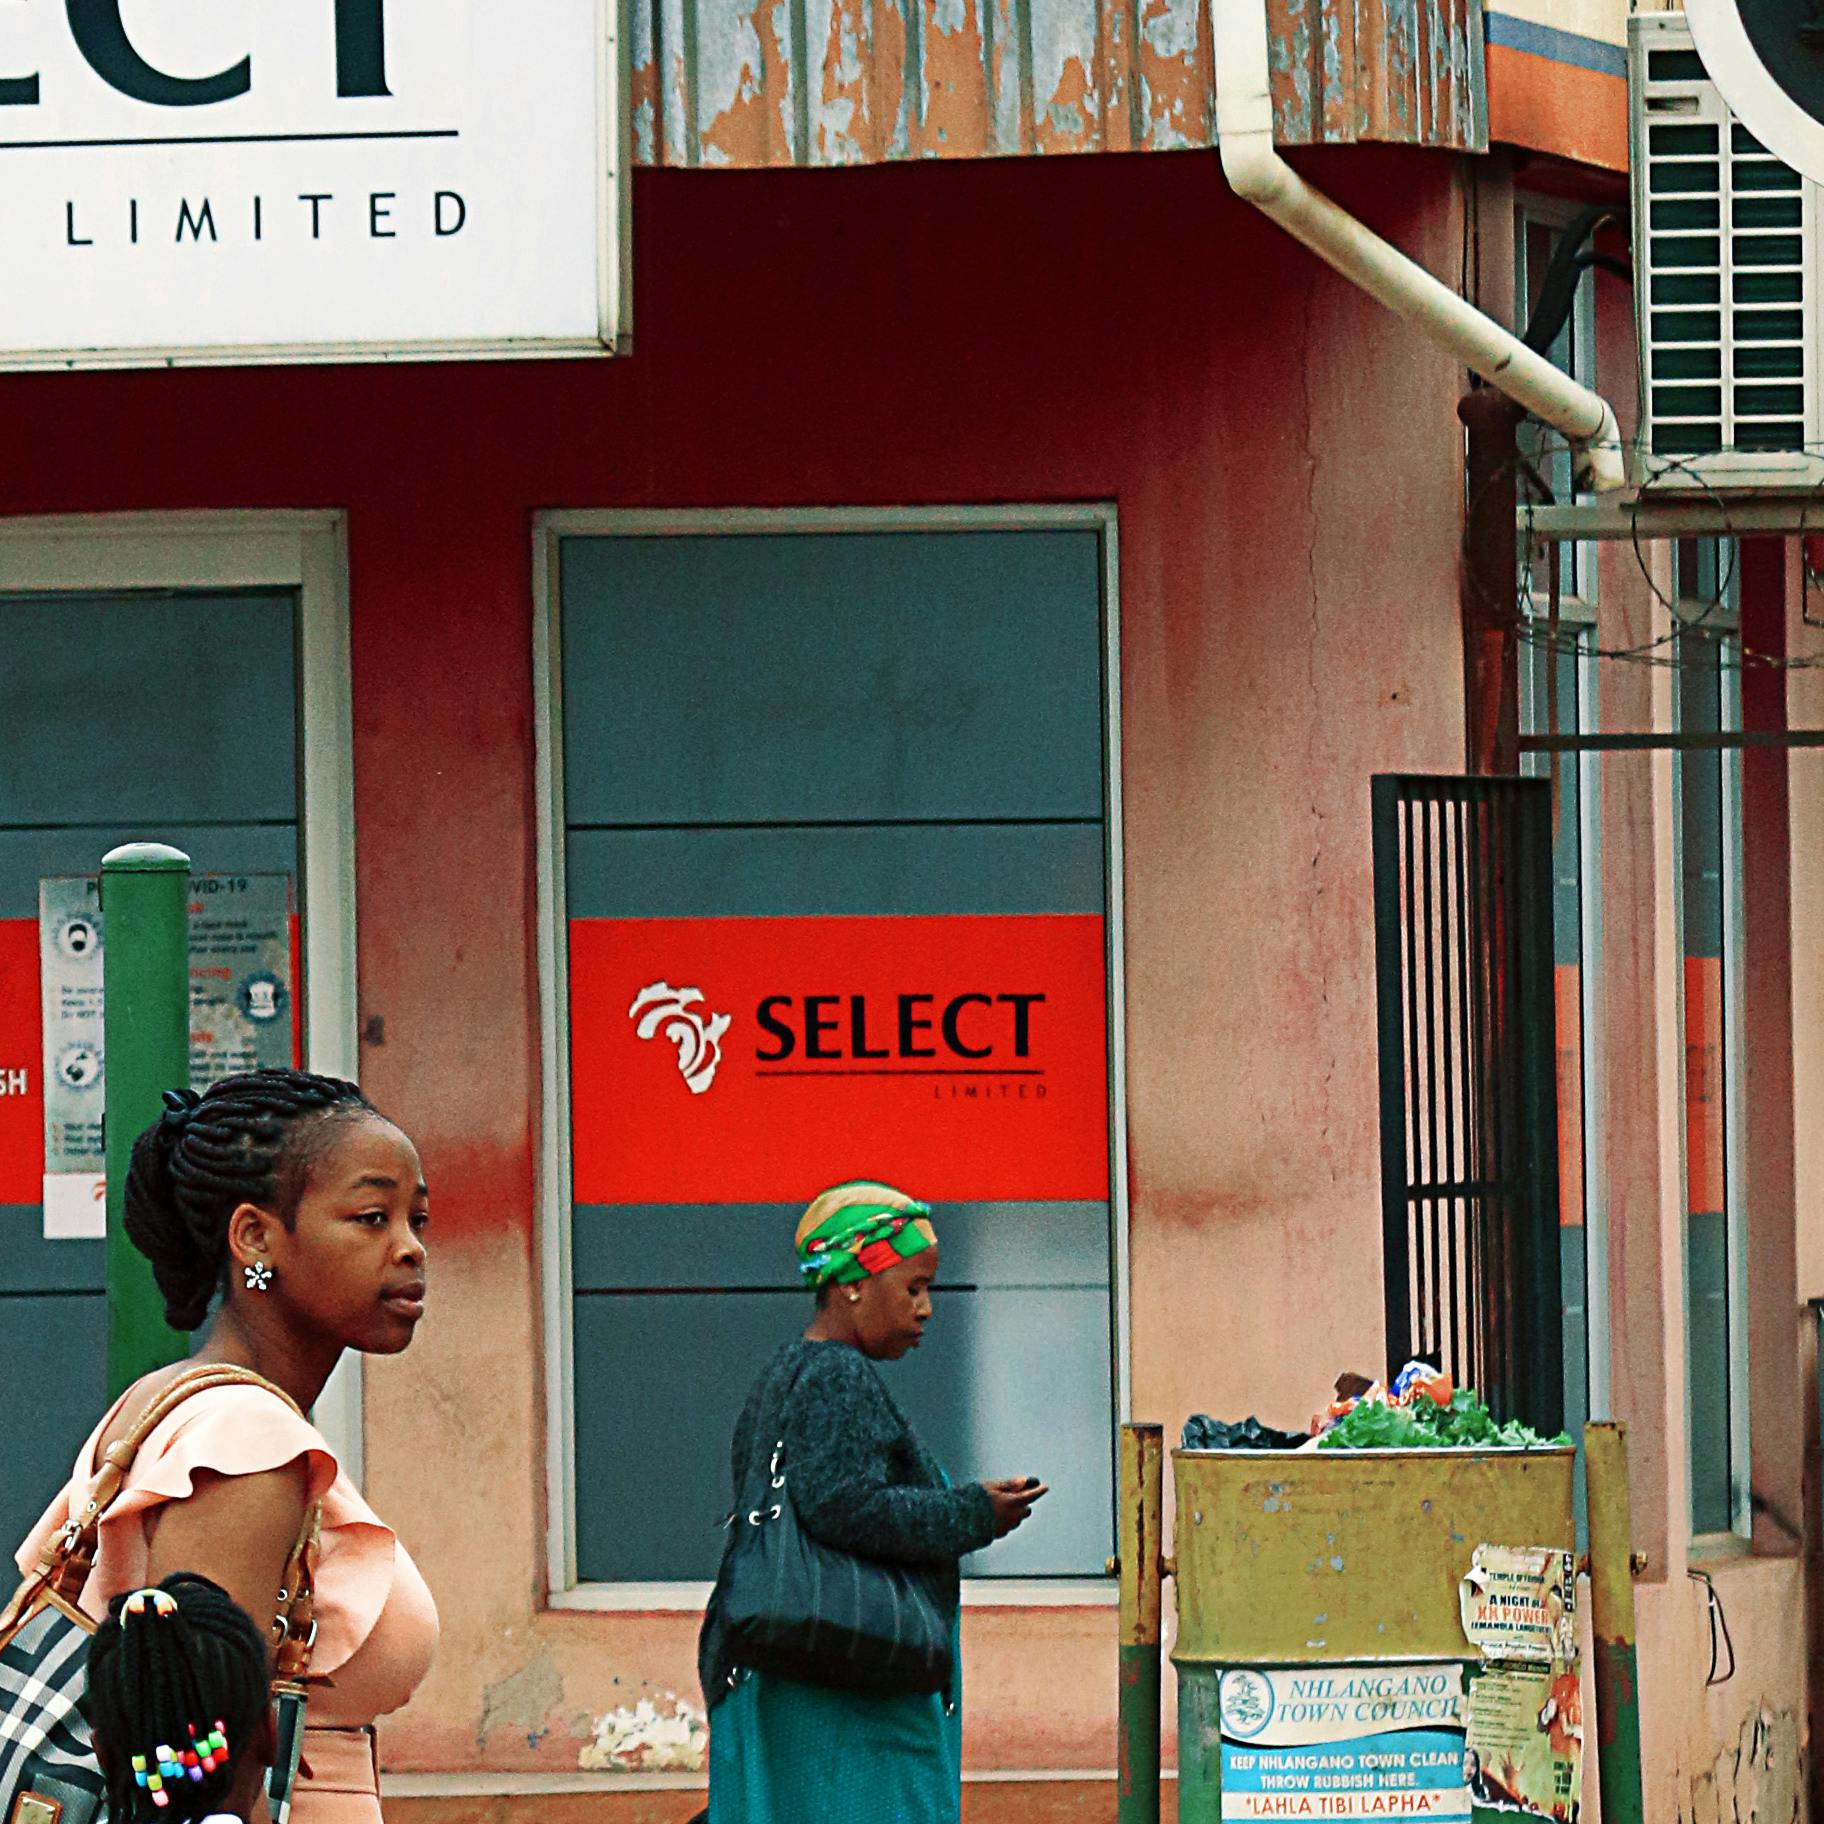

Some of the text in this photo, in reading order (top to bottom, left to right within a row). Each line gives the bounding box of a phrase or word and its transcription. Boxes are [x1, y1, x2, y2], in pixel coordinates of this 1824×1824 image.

[65, 190, 468, 246] LIMITED
[189, 878, 247, 894] VID-19
[756, 993, 1046, 1061] SELECT
[934, 1084, 1047, 1099] LIMITED
[1489, 1594, 1497, 1606] A
[1500, 1594, 1530, 1608] NIGHT
[1502, 1606, 1549, 1625] POWER
[1289, 1675, 1448, 1700] NHLANGANO
[1278, 1695, 1458, 1724] TOWN COUNCIL
[1230, 1751, 1459, 1771] KEEP NHLANGANO TOWN CLEAN
[1260, 1774, 1309, 1790] THROW
[1313, 1773, 1375, 1789] RUBBISH
[1319, 1795, 1352, 1815] TIBI
